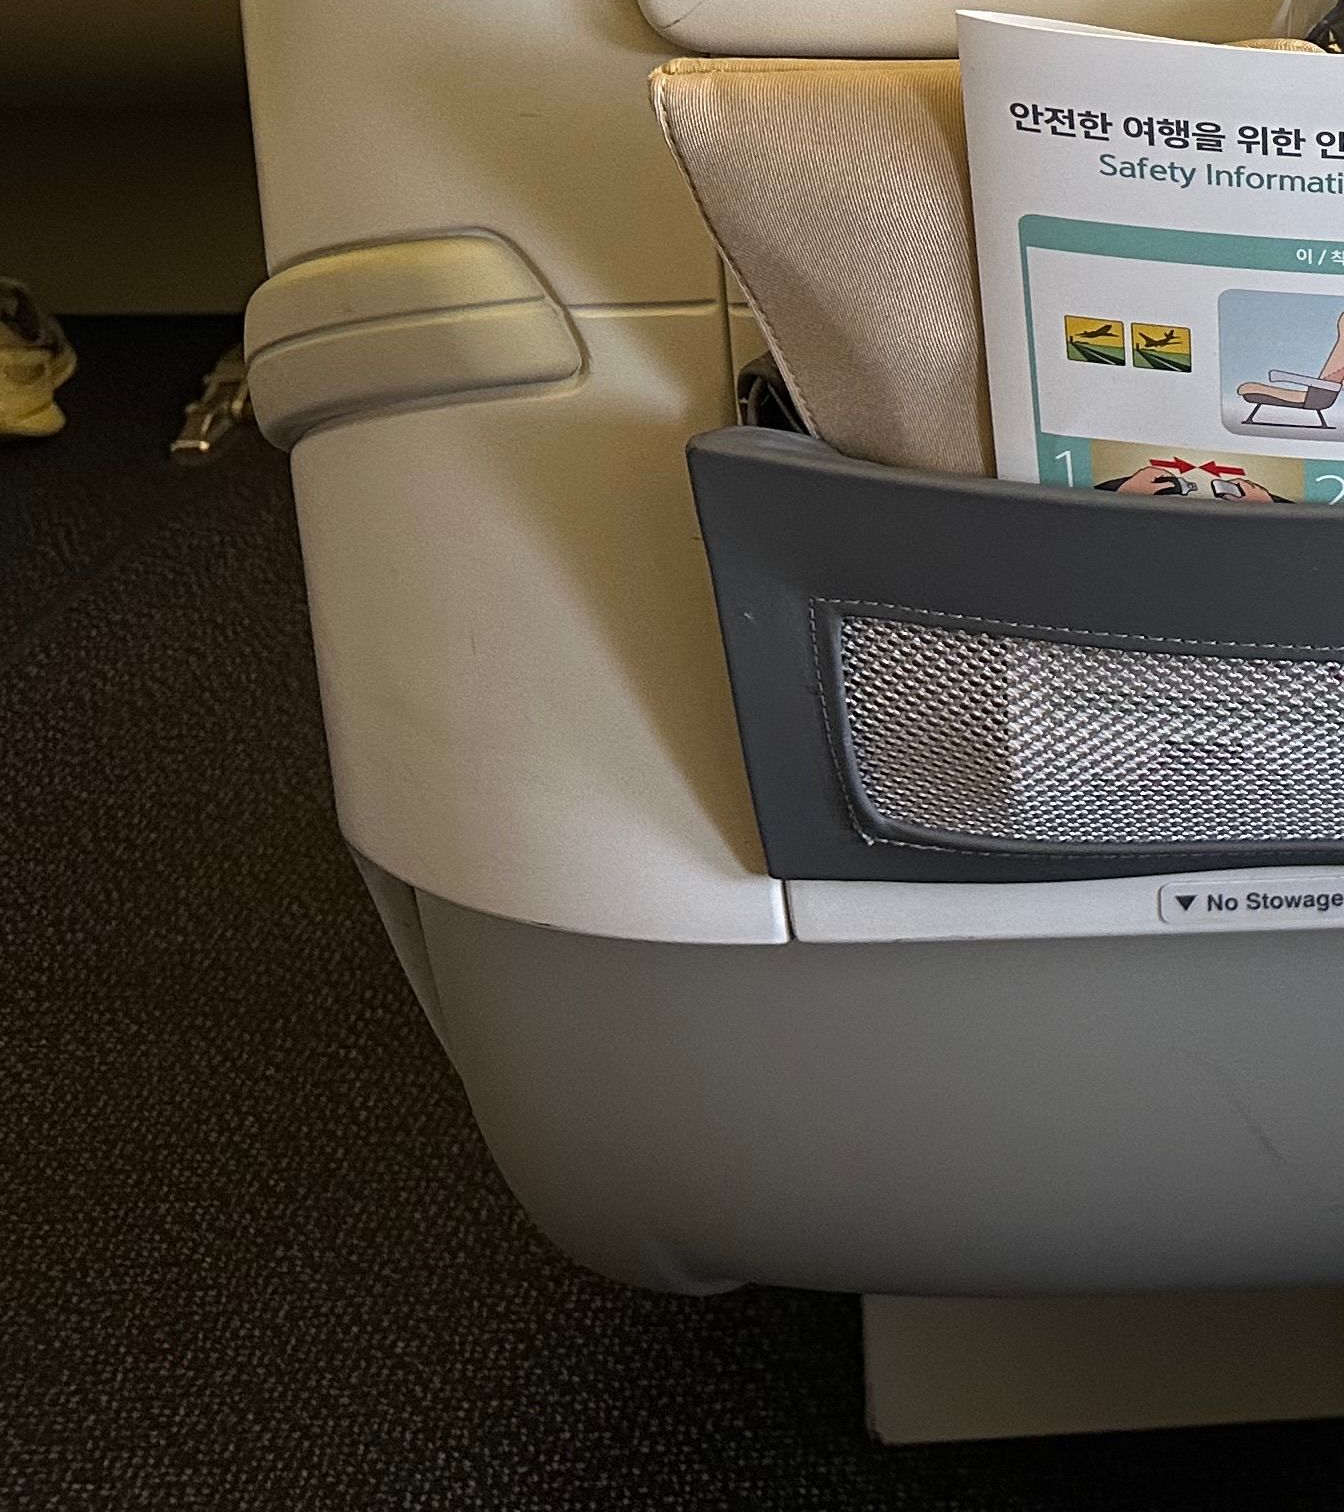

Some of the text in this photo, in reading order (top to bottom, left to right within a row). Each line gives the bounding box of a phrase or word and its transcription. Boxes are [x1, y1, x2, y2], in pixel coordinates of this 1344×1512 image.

[1010, 102, 1113, 141] 안전한
[1123, 116, 1226, 153] 여행을
[1237, 125, 1306, 158] 위한
[1100, 154, 1196, 189] Safety
[1296, 249, 1313, 265] 이
[1055, 450, 1074, 487] 1
[1207, 893, 1239, 912] No
[1246, 889, 1344, 912] Stowage
